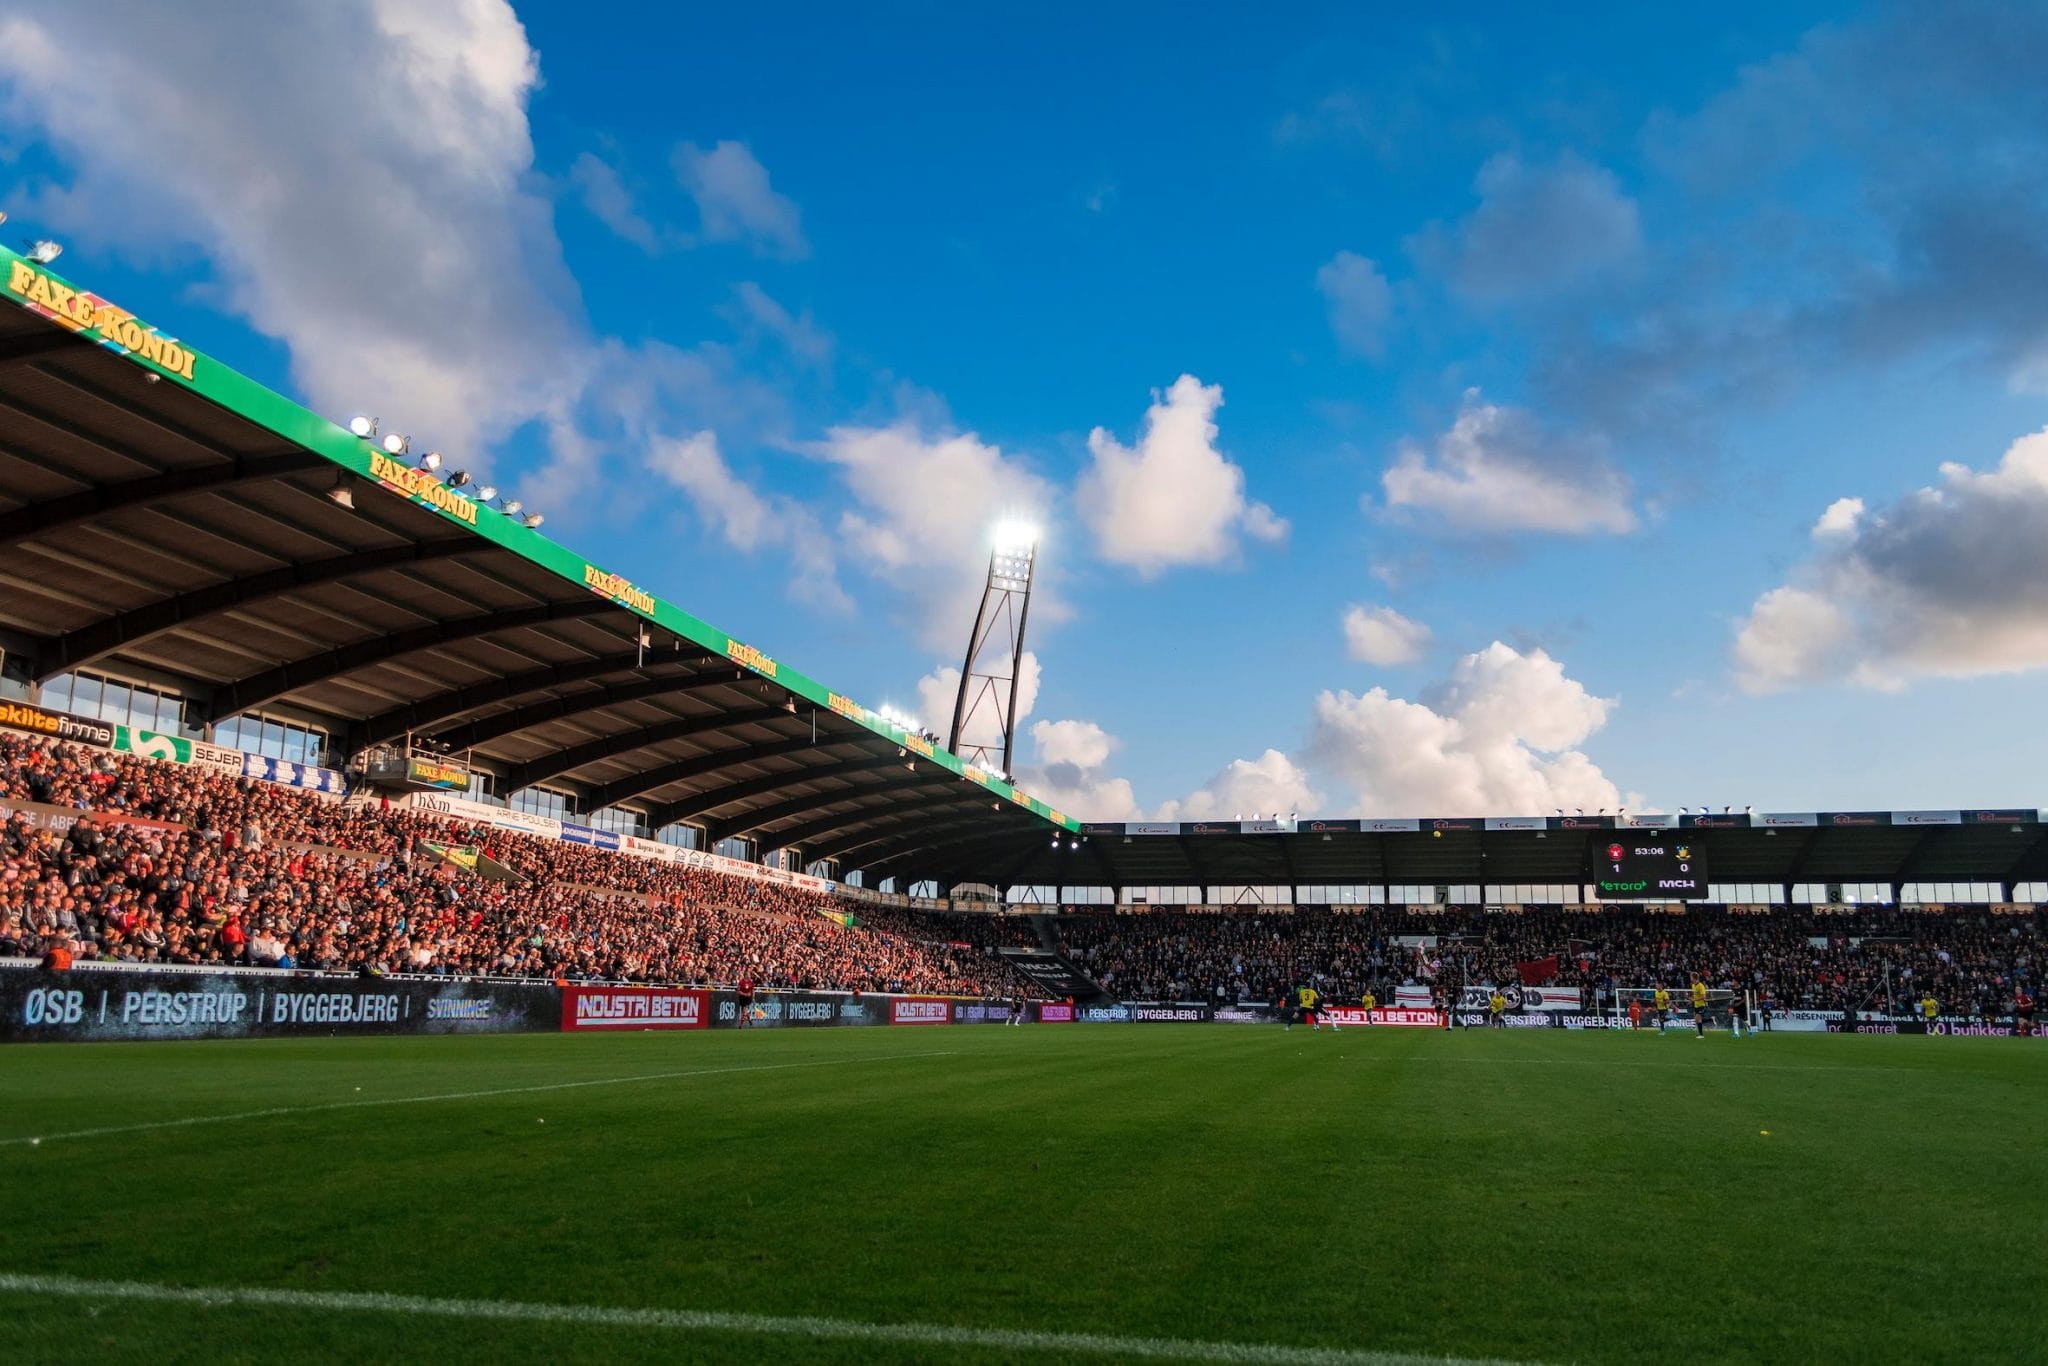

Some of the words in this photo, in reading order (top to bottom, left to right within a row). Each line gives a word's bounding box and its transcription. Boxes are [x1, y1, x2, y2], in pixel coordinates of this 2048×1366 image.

[9, 260, 95, 328] FAXE
[100, 308, 196, 381] KONDI
[370, 451, 419, 495] FAXE
[418, 478, 478, 525] KONDI
[585, 564, 617, 595] FAXE
[617, 583, 655, 616] KONDI
[727, 639, 750, 662] FAXE
[750, 653, 777, 678] KONDI
[195, 747, 242, 767] SEJER
[416, 763, 437, 777] FAXE
[439, 770, 467, 785] KONDI
[418, 792, 450, 812] h&m
[1634, 847, 1664, 855] 53:06
[1612, 864, 1620, 873] 1
[1680, 864, 1689, 872] 0
[1659, 880, 1695, 888] MCH
[1438, 892, 1446, 902] 7
[25, 988, 84, 1026] ØSB
[123, 991, 247, 1025] PERSTRUP
[273, 993, 399, 1023] BYGGEBJERG
[428, 999, 490, 1019] SVINNINGE
[577, 995, 649, 1017] INDUSTRI
[652, 997, 699, 1017] BETON
[720, 1001, 736, 1020] ØSB
[790, 1002, 831, 1020] BYGGEBJERG
[1089, 1008, 1128, 1019] PERSTRUP
[1137, 1009, 1198, 1021] BYGGEBJERG
[1213, 1011, 1253, 1020] SVINNINGE
[1387, 1011, 1438, 1022] BETON
[1504, 1015, 1550, 1026] ERSTRUP
[1563, 1016, 1633, 1027] BYGGEBJERG
[1951, 1022, 2012, 1036] butikker
